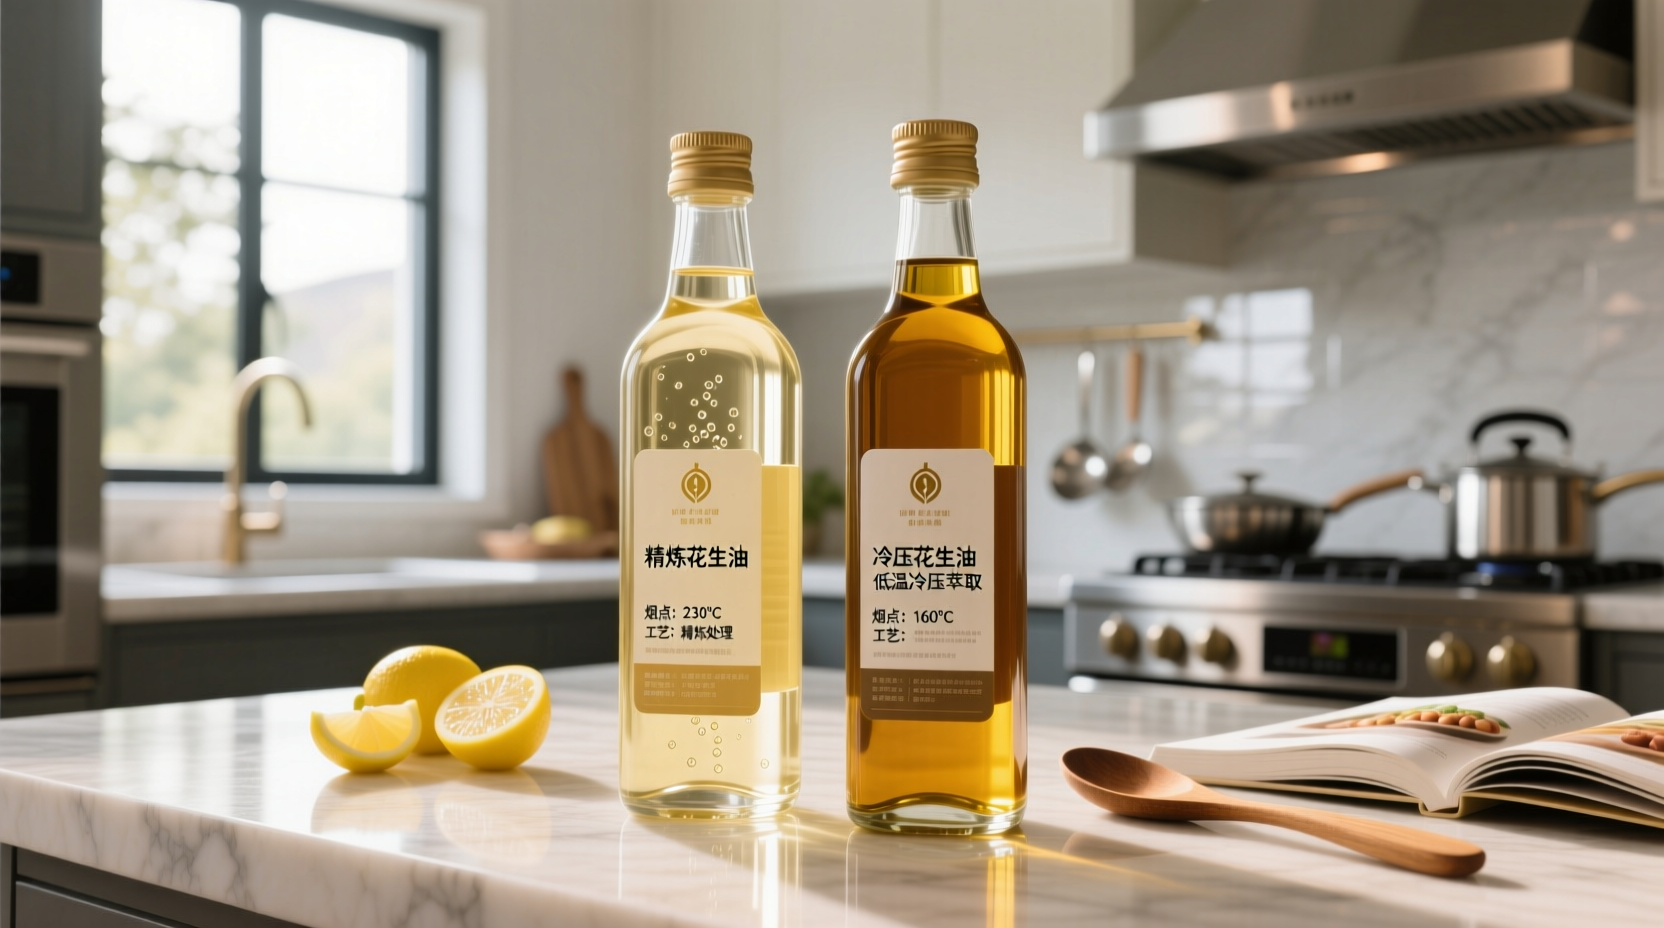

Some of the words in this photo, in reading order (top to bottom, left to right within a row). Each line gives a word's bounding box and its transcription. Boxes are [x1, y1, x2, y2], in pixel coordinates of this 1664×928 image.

[644, 544, 749, 569] 精炼花生油
[873, 545, 976, 568] 冷压花生油
[873, 571, 983, 591] 低温冷压萃取
